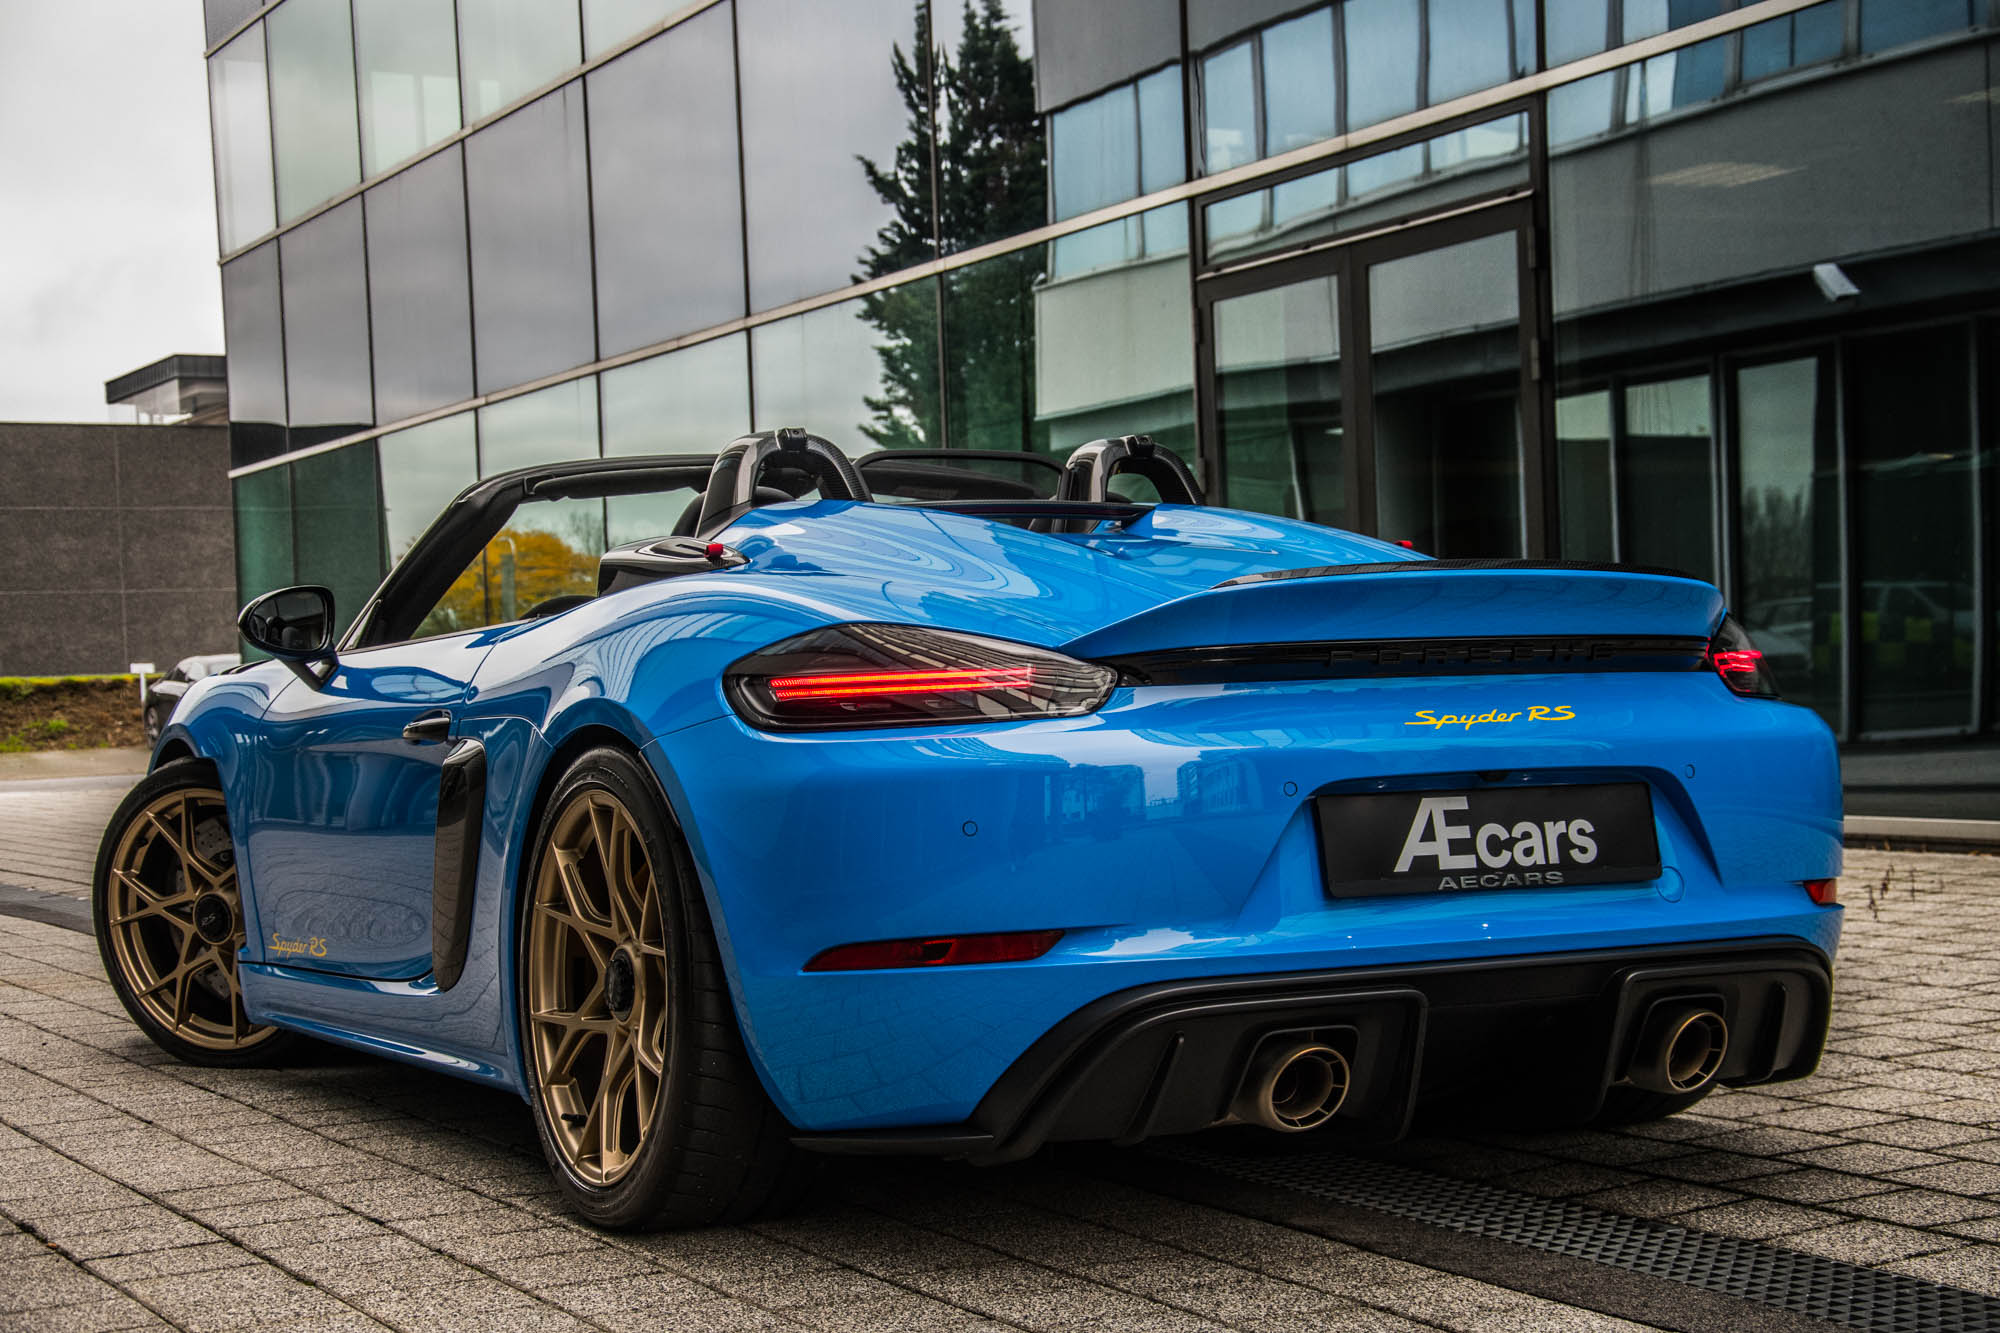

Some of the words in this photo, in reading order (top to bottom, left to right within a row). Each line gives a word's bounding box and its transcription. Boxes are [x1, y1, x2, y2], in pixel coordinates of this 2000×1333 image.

[1404, 708, 1522, 731] Spyder
[1527, 705, 1577, 722] RS
[1438, 871, 1564, 891] AECARS
[268, 933, 308, 959] Spyder
[310, 937, 327, 957] RS
